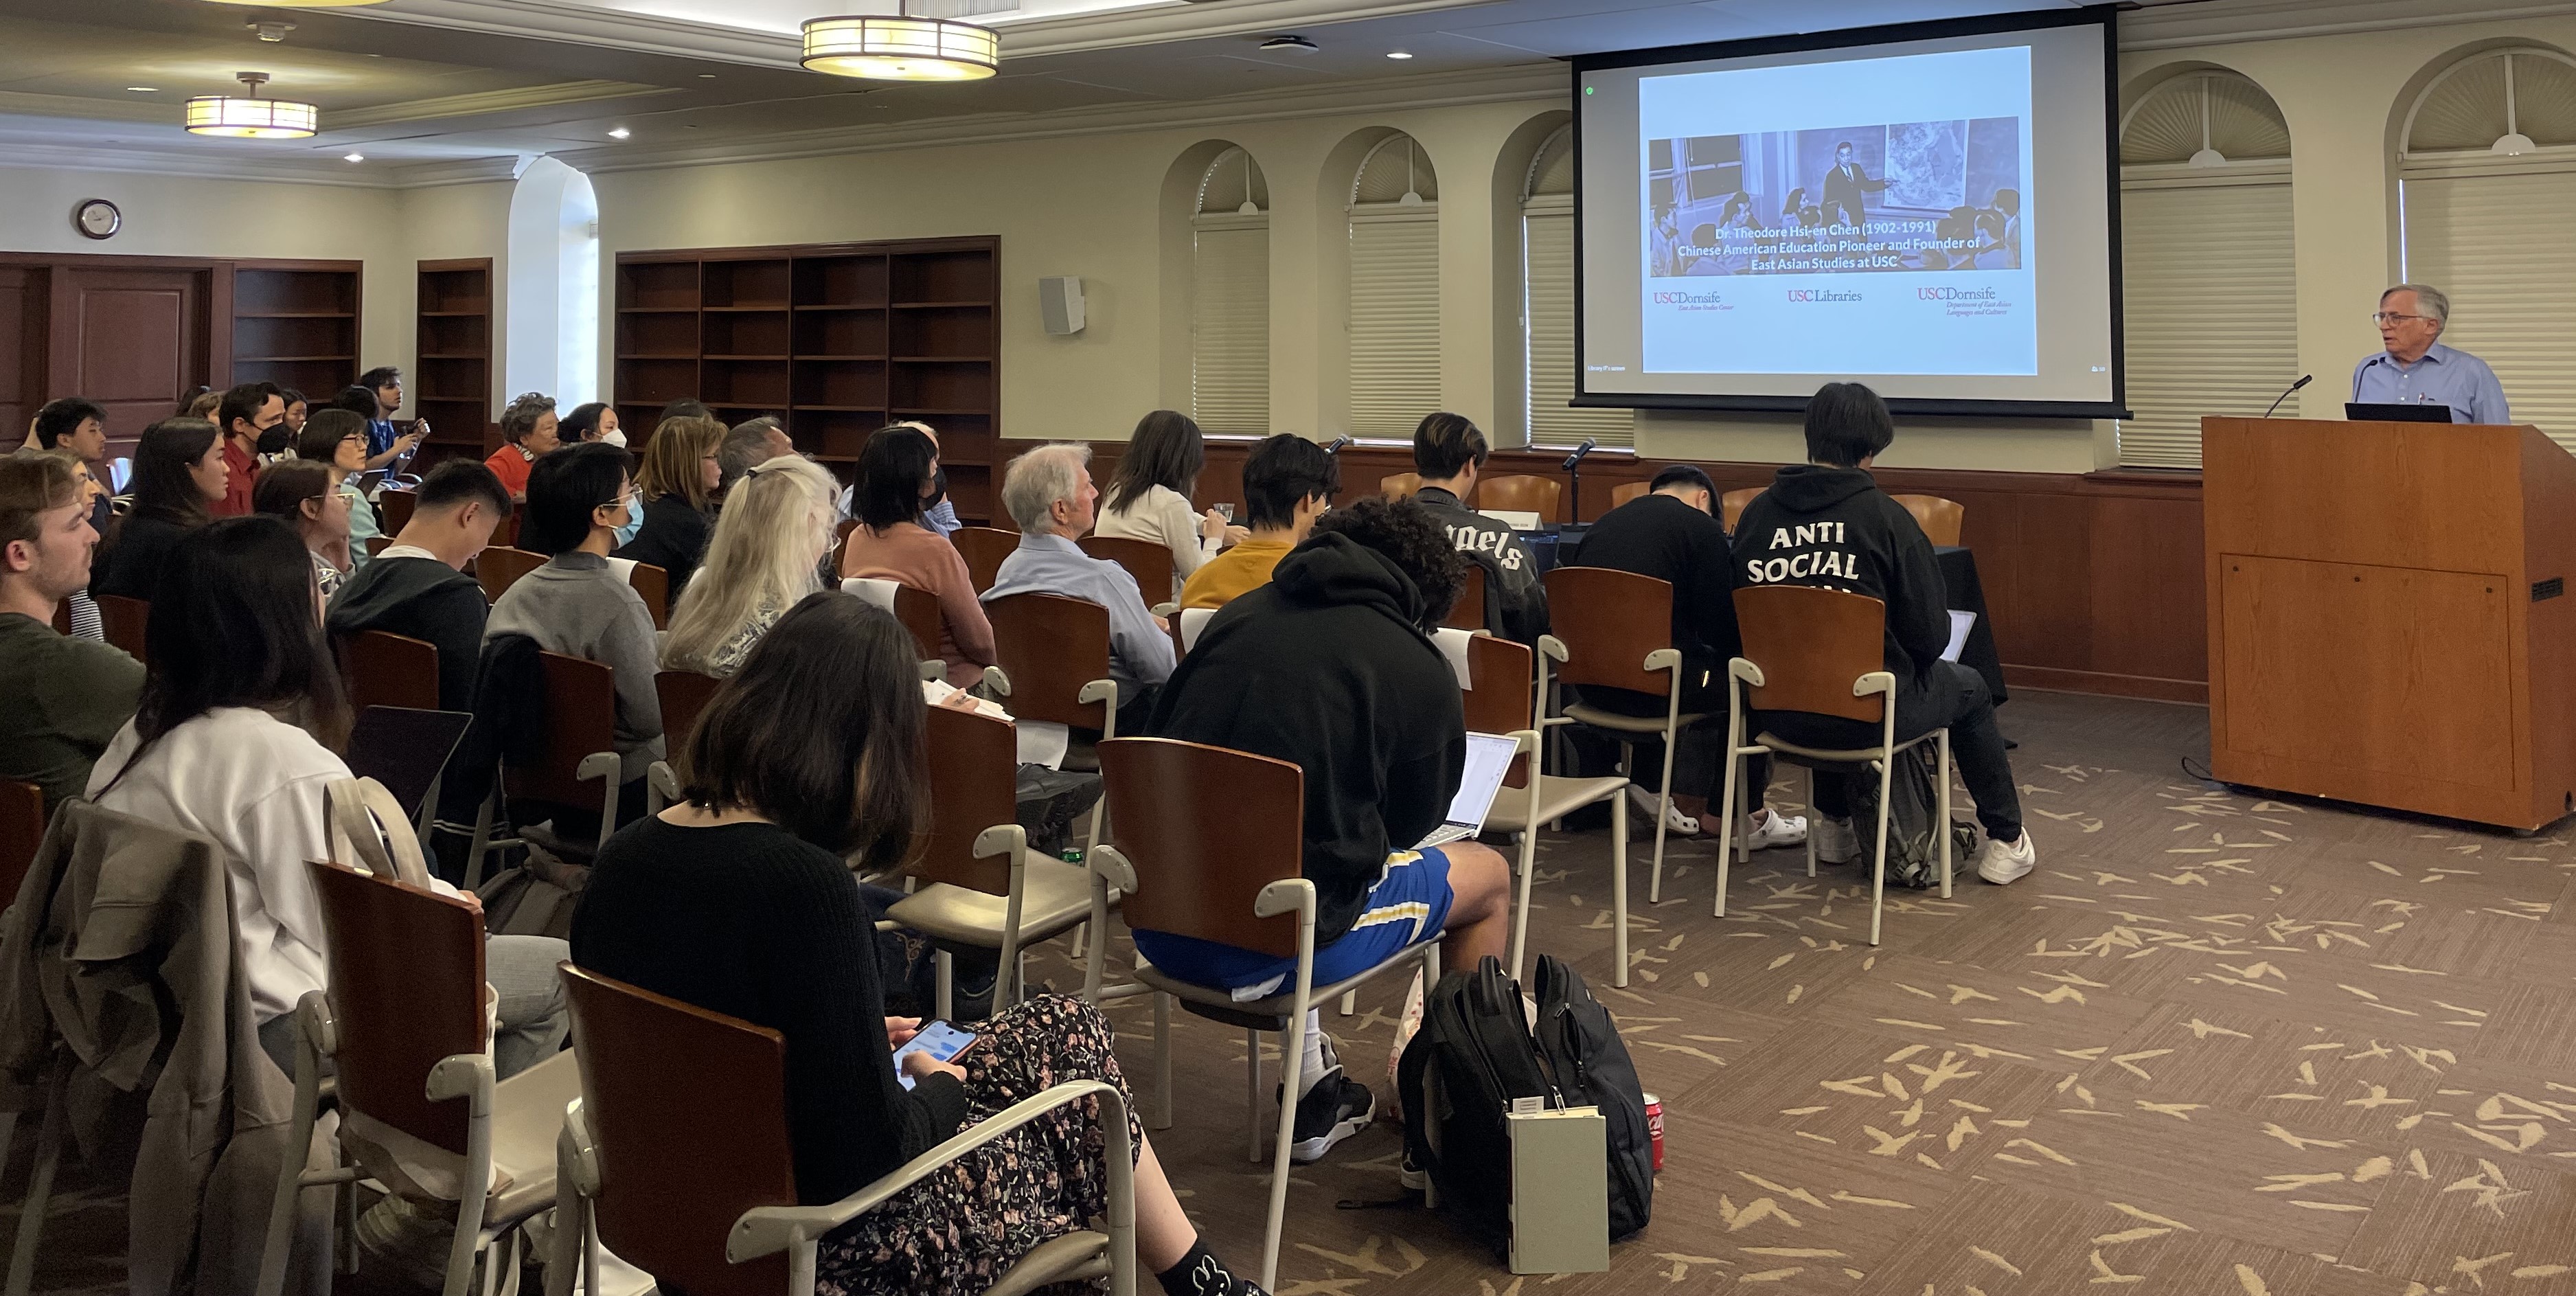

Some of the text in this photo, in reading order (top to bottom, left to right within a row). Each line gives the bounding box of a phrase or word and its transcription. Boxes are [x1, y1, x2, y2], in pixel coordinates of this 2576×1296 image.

[1716, 220, 1936, 240] Dr. Theodore Hsi-en Chen (1902-1991)
[1678, 236, 1981, 257] Chinese American Education Pioneer and Founder of
[1751, 255, 1897, 271] East Asian Studies at USC
[1788, 289, 1862, 302] USC Libraries
[1768, 521, 1845, 550] ANTI
[1747, 551, 1859, 583] SOCIAL
